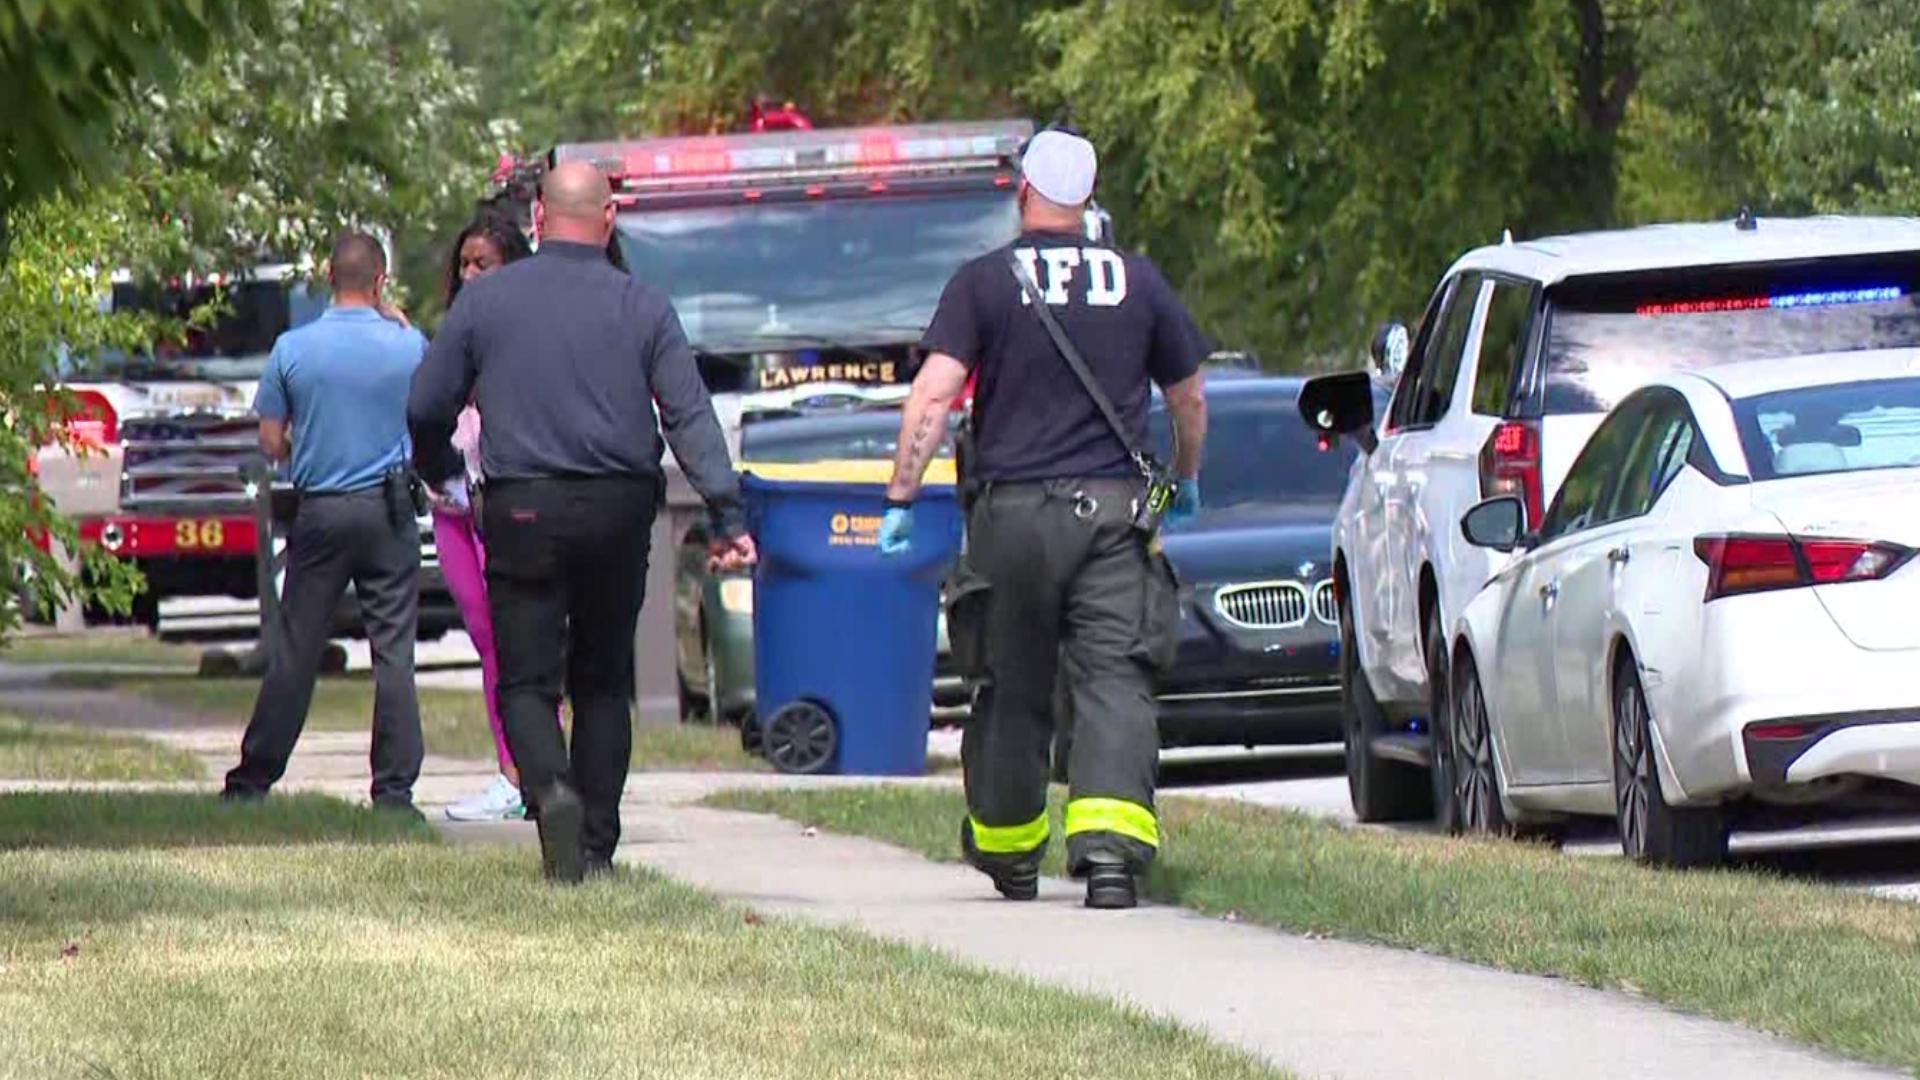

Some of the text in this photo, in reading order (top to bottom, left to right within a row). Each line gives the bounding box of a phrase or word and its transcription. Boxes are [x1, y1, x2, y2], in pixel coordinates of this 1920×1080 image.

[1013, 246, 1127, 306] IFD
[760, 361, 896, 388] LAWRENCE
[175, 519, 224, 547] 36
